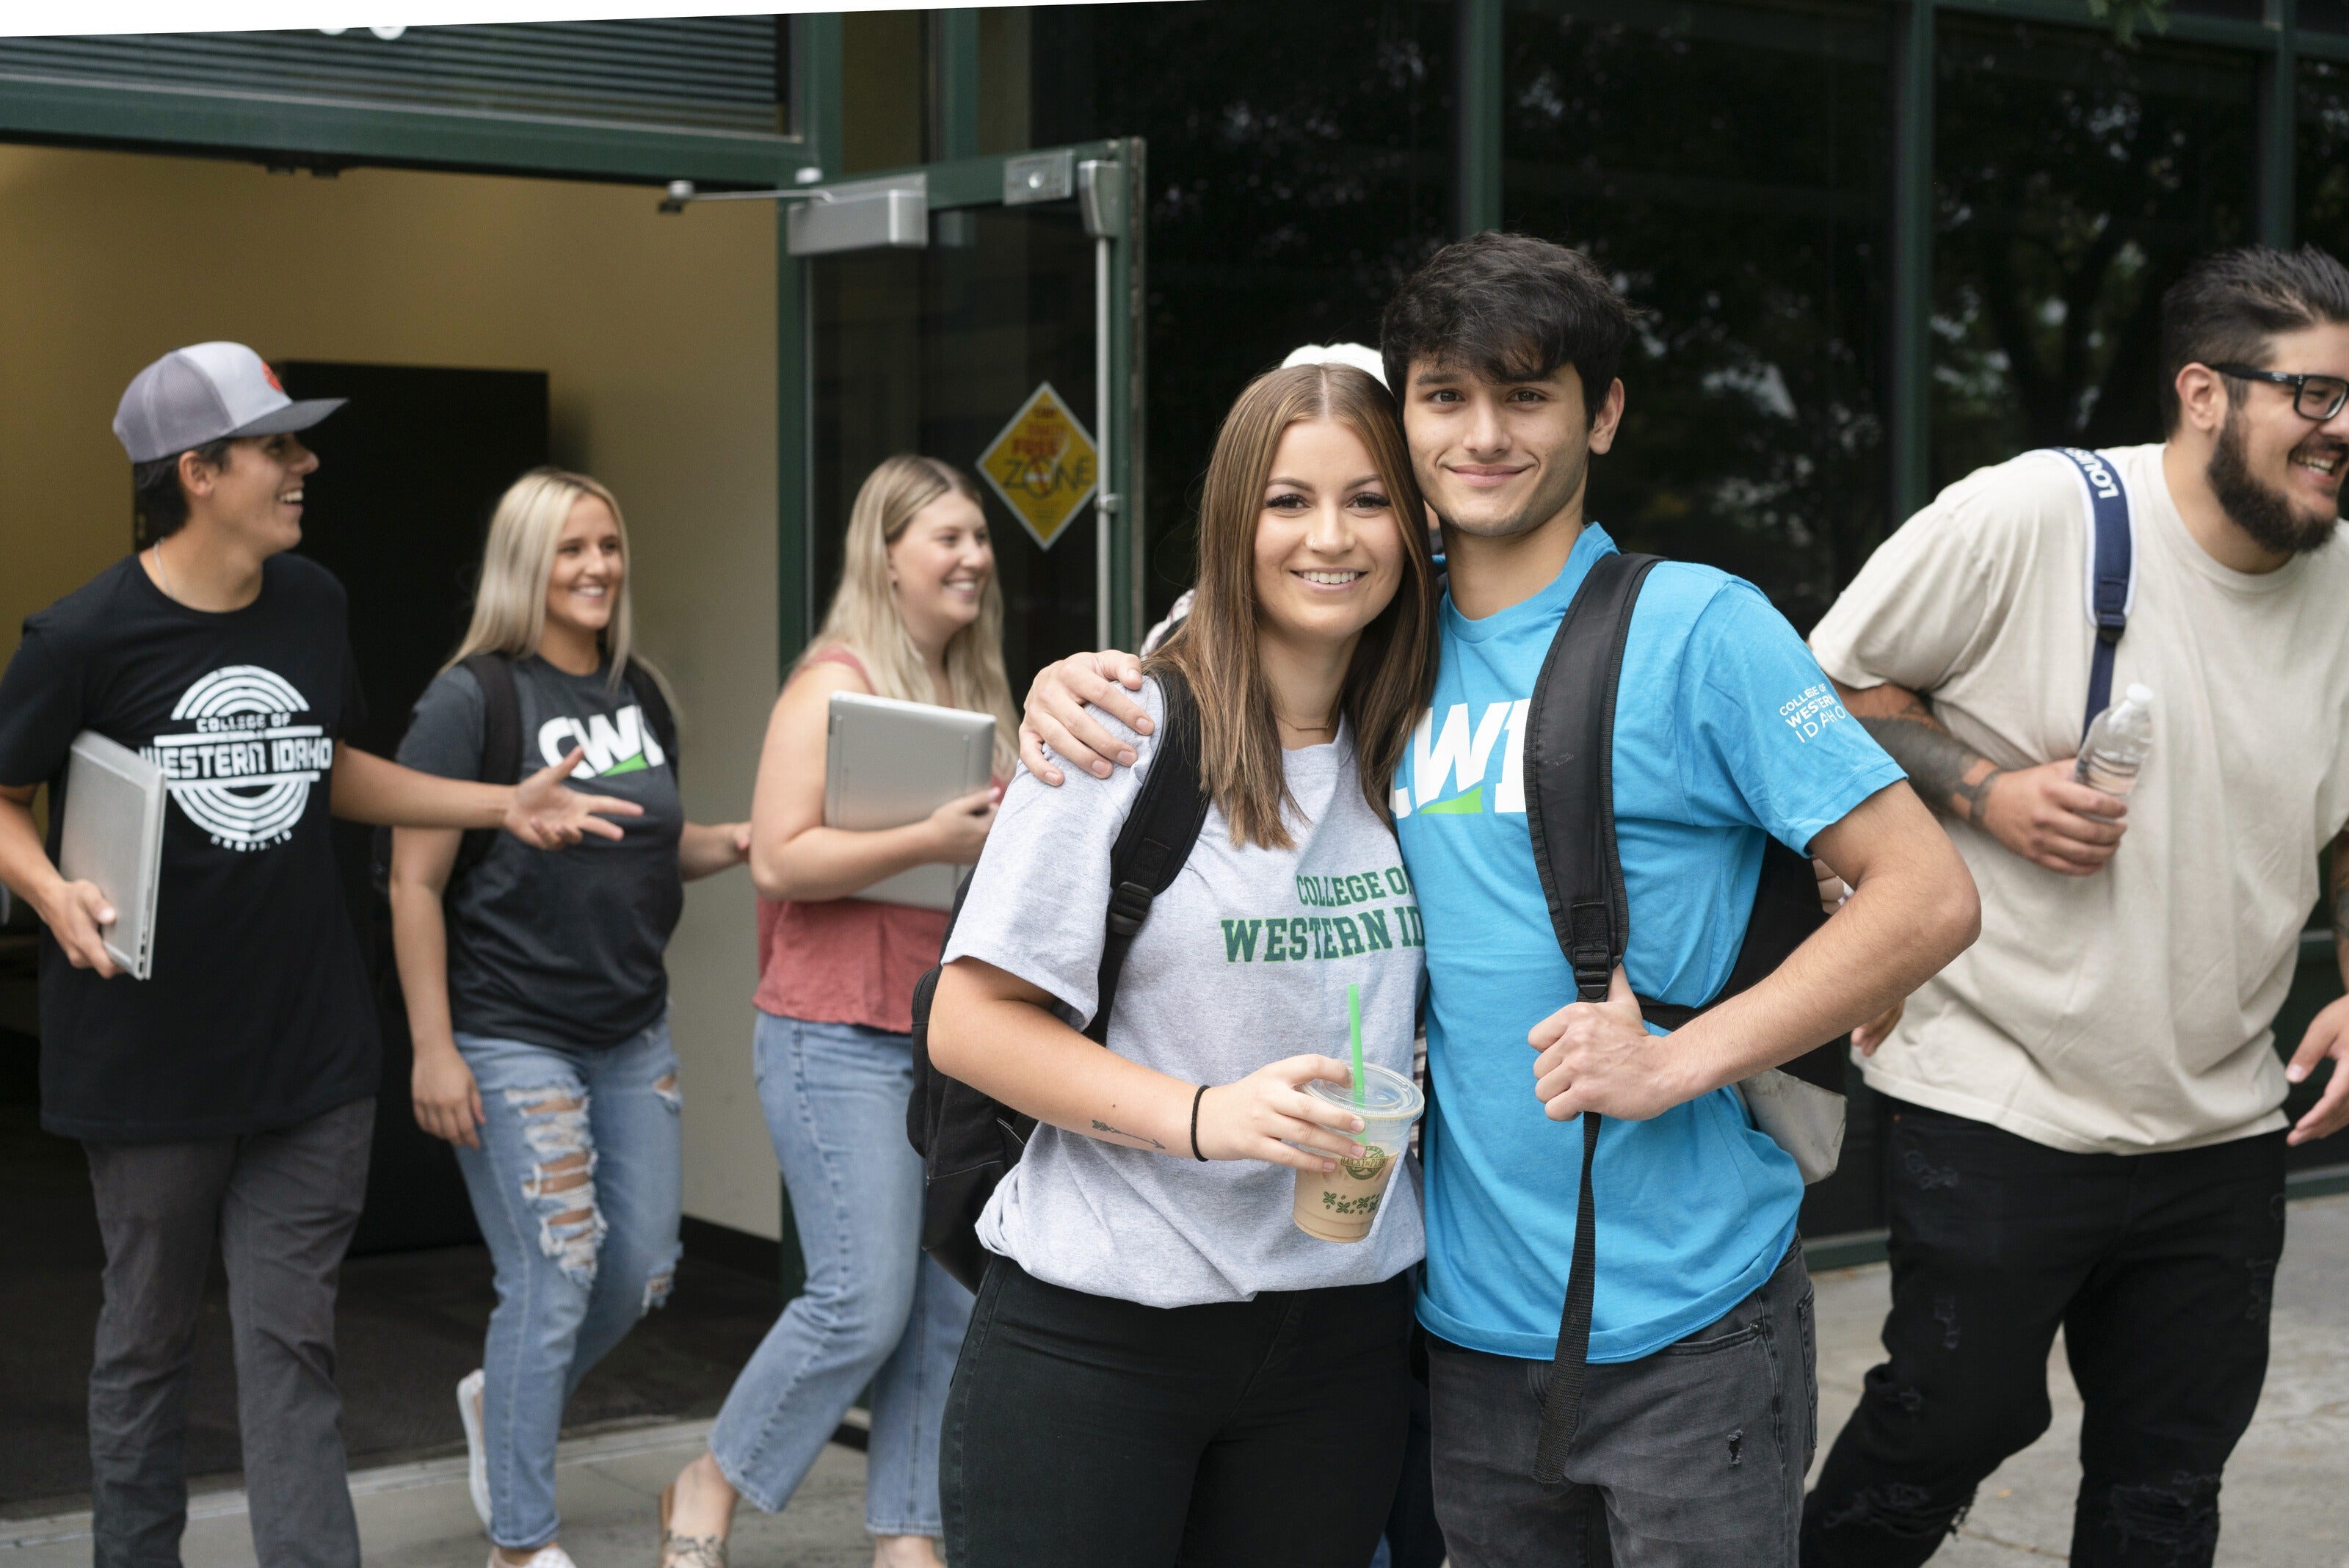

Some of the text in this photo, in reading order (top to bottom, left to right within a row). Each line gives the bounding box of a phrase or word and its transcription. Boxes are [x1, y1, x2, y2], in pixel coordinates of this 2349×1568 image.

[1003, 455, 1092, 500] ZONE
[196, 712, 292, 733] COLLEGE OF
[1795, 705, 1846, 744] IDAHO
[271, 737, 334, 774] IDAHO
[1389, 698, 1531, 819] WI
[1296, 866, 1414, 907] COLLEGE O
[1220, 909, 1393, 963] WESTERN
